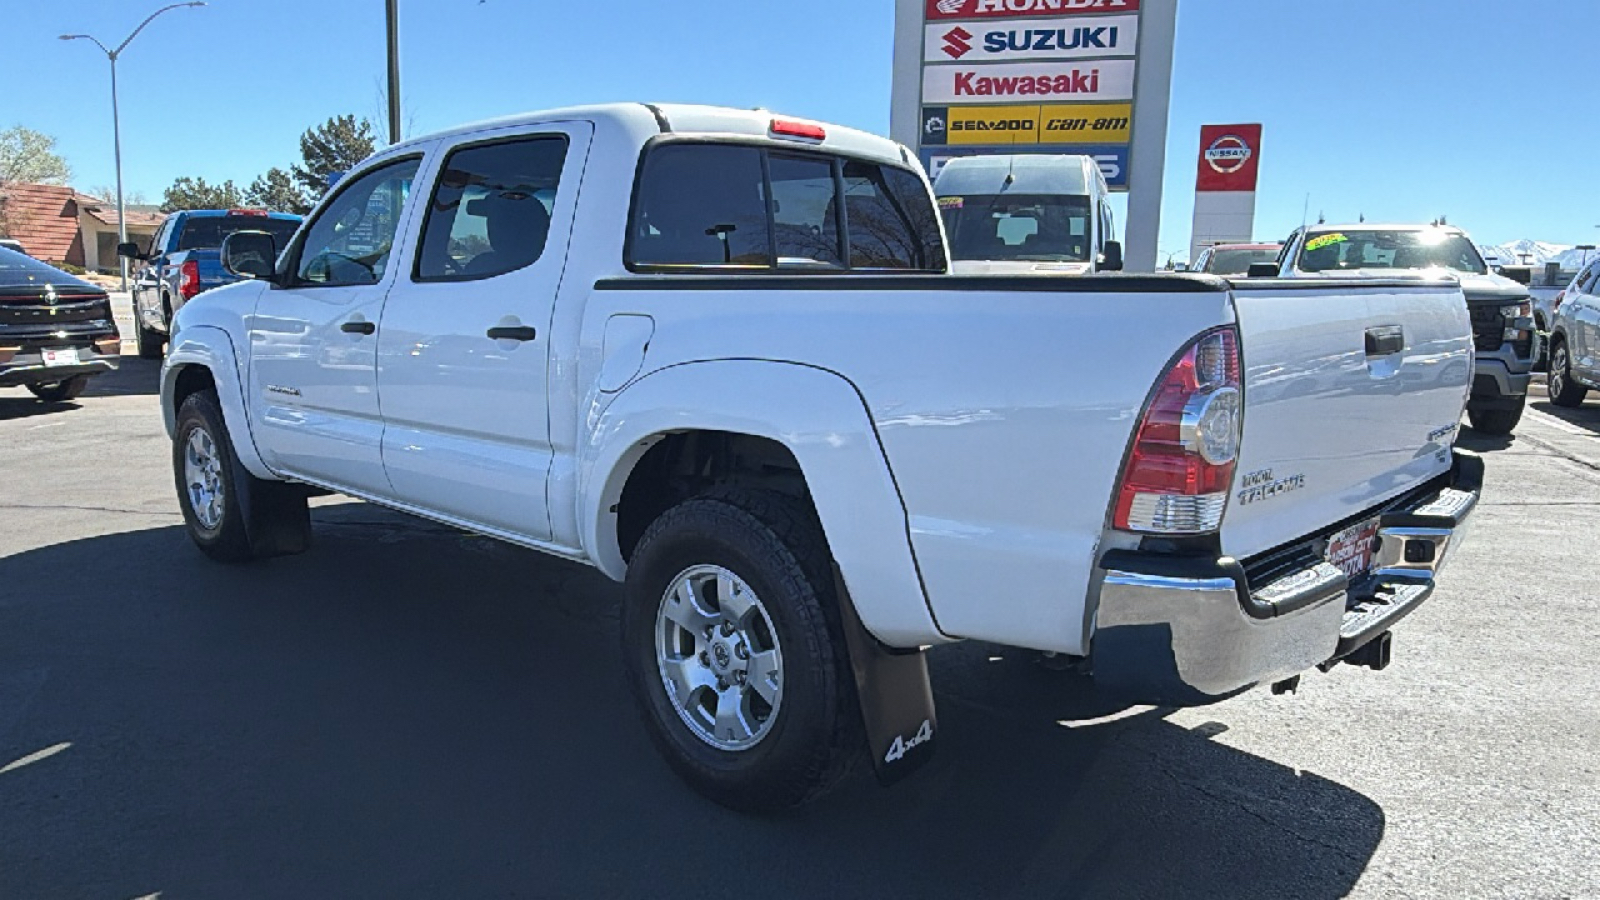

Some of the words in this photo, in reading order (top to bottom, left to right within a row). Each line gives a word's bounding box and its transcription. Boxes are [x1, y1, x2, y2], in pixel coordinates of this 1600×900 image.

[983, 26, 1118, 52] SUZUKI
[954, 69, 1099, 95] Kawasaki
[1238, 474, 1304, 505] TACOMA
[884, 719, 933, 763] 4x4
